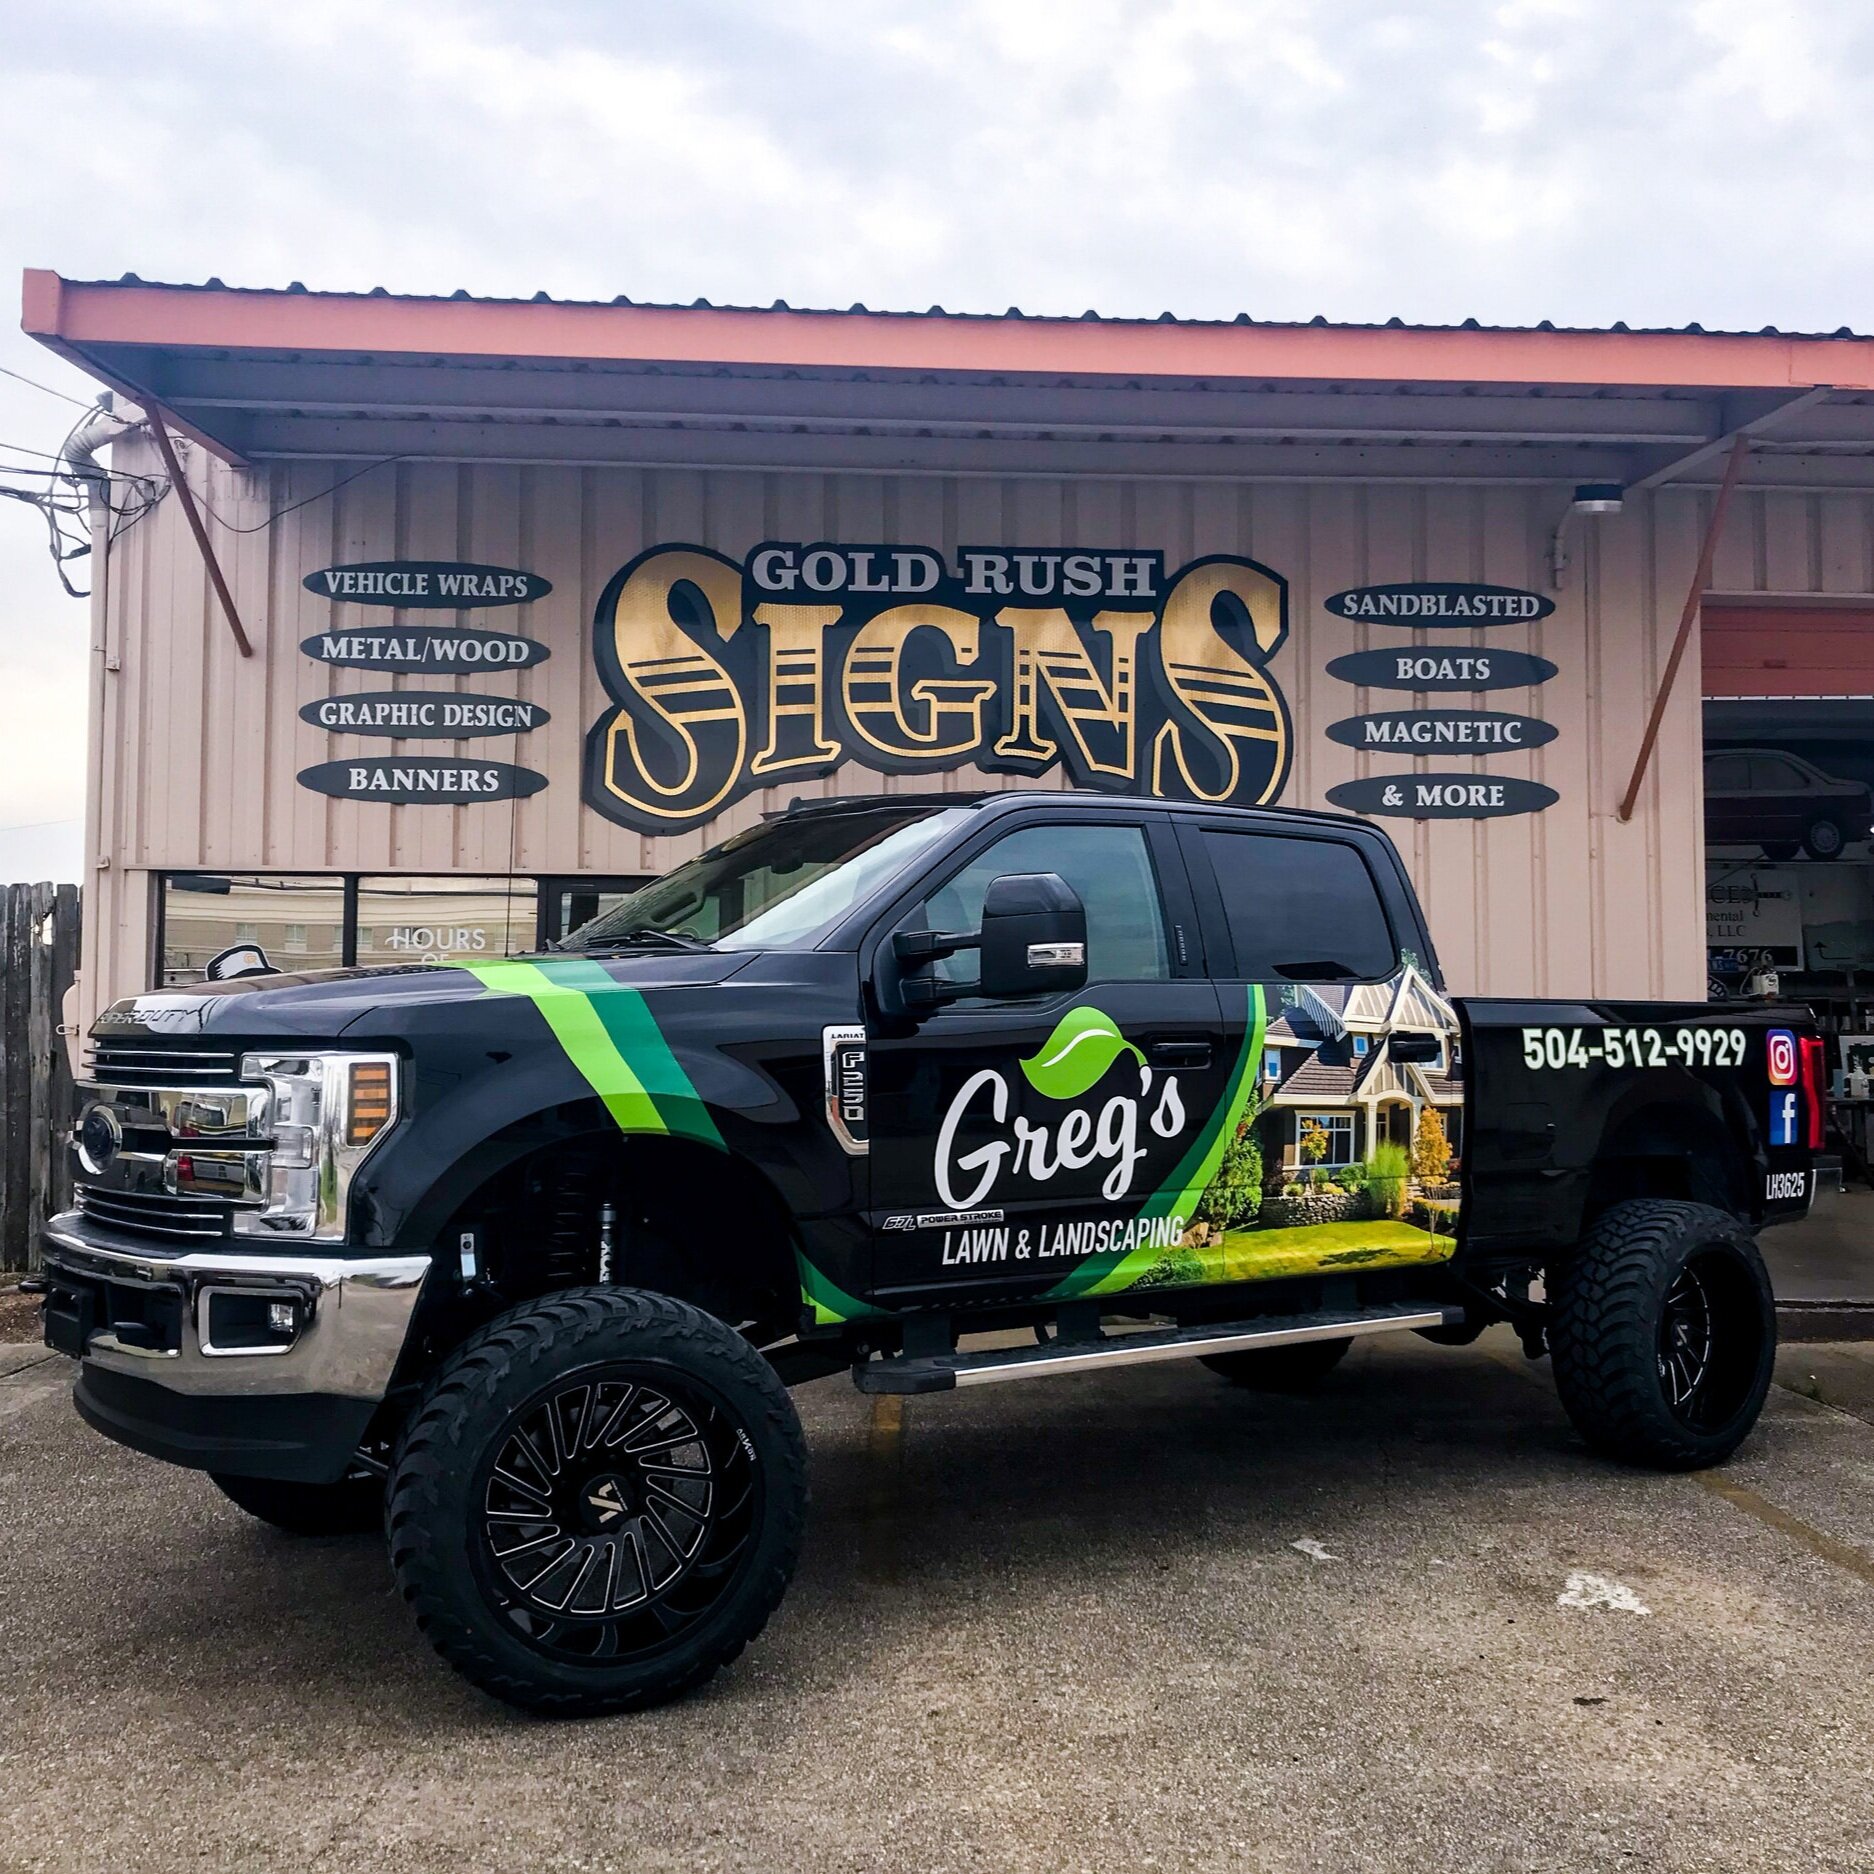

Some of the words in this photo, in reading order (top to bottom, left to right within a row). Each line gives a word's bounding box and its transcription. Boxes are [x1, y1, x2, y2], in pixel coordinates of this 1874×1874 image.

[325, 571, 428, 596] VEHICLE
[438, 573, 528, 598] WRAPS
[753, 550, 939, 594] GOLD
[965, 553, 1156, 598] RUSH
[1343, 594, 1540, 617] SANDBLASTED
[321, 636, 529, 663] METAL/WOOD
[1396, 657, 1490, 680] BOATS
[604, 551, 1286, 819] SIGNS
[319, 702, 435, 726] GRAPHIC
[443, 704, 533, 728] DESIGN
[1364, 721, 1522, 743] MAGNETIC
[349, 768, 499, 792] BANNERS
[1382, 784, 1403, 807] &
[1416, 785, 1505, 807] MORE
[385, 927, 486, 950] HOURS
[1522, 1028, 1746, 1070] 504-512-9929
[934, 1065, 1185, 1209] Greg's
[1766, 1172, 1805, 1200] LH3625
[921, 1214, 959, 1225] POWER
[959, 1211, 1003, 1222] STROKE
[942, 1227, 1009, 1265] LAWN
[1015, 1229, 1031, 1259] &
[1038, 1215, 1184, 1258] LANDSCAPING
